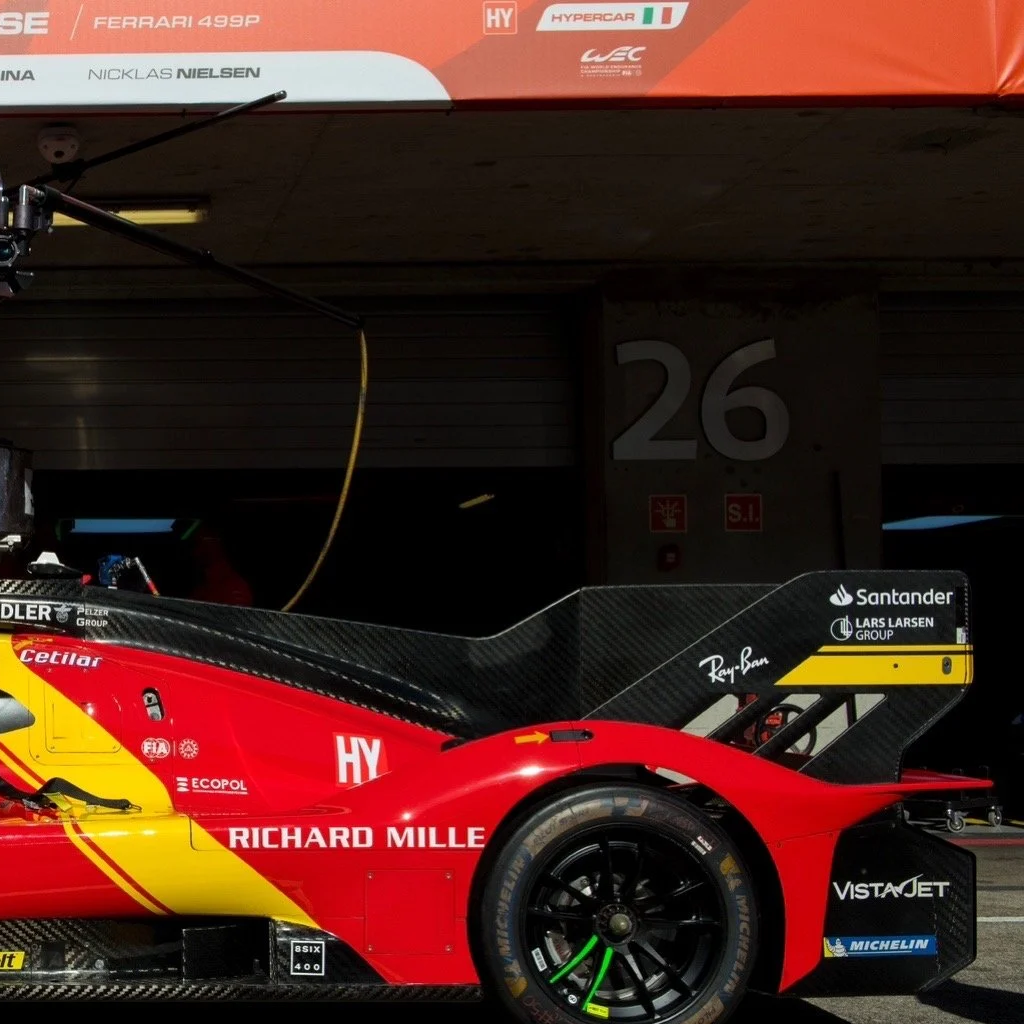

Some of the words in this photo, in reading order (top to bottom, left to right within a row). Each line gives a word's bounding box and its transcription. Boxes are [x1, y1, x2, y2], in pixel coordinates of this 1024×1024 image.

[93, 15, 193, 30] FERRARI
[197, 14, 260, 28] 499P
[486, 7, 513, 29] HY
[551, 12, 635, 23] HYPERCAR
[580, 46, 647, 62] WEC
[87, 67, 172, 82] NICKLAS
[175, 66, 261, 80] NIELSEN
[612, 337, 790, 461] 26
[856, 588, 953, 605] Santander
[856, 618, 886, 629] LARS
[888, 617, 934, 629] LARSEN
[856, 629, 894, 641] GROUP
[19, 649, 103, 669] Cetilar
[698, 646, 769, 684] Ray-Ban
[143, 741, 169, 755] FIA
[336, 735, 381, 784] HY
[192, 778, 247, 791] ECOPOL
[228, 826, 373, 849] RICHARD
[387, 826, 485, 849] MILLE
[294, 945, 321, 953] 8SIX
[849, 939, 929, 951] MICHELIN
[294, 963, 320, 971] 400
